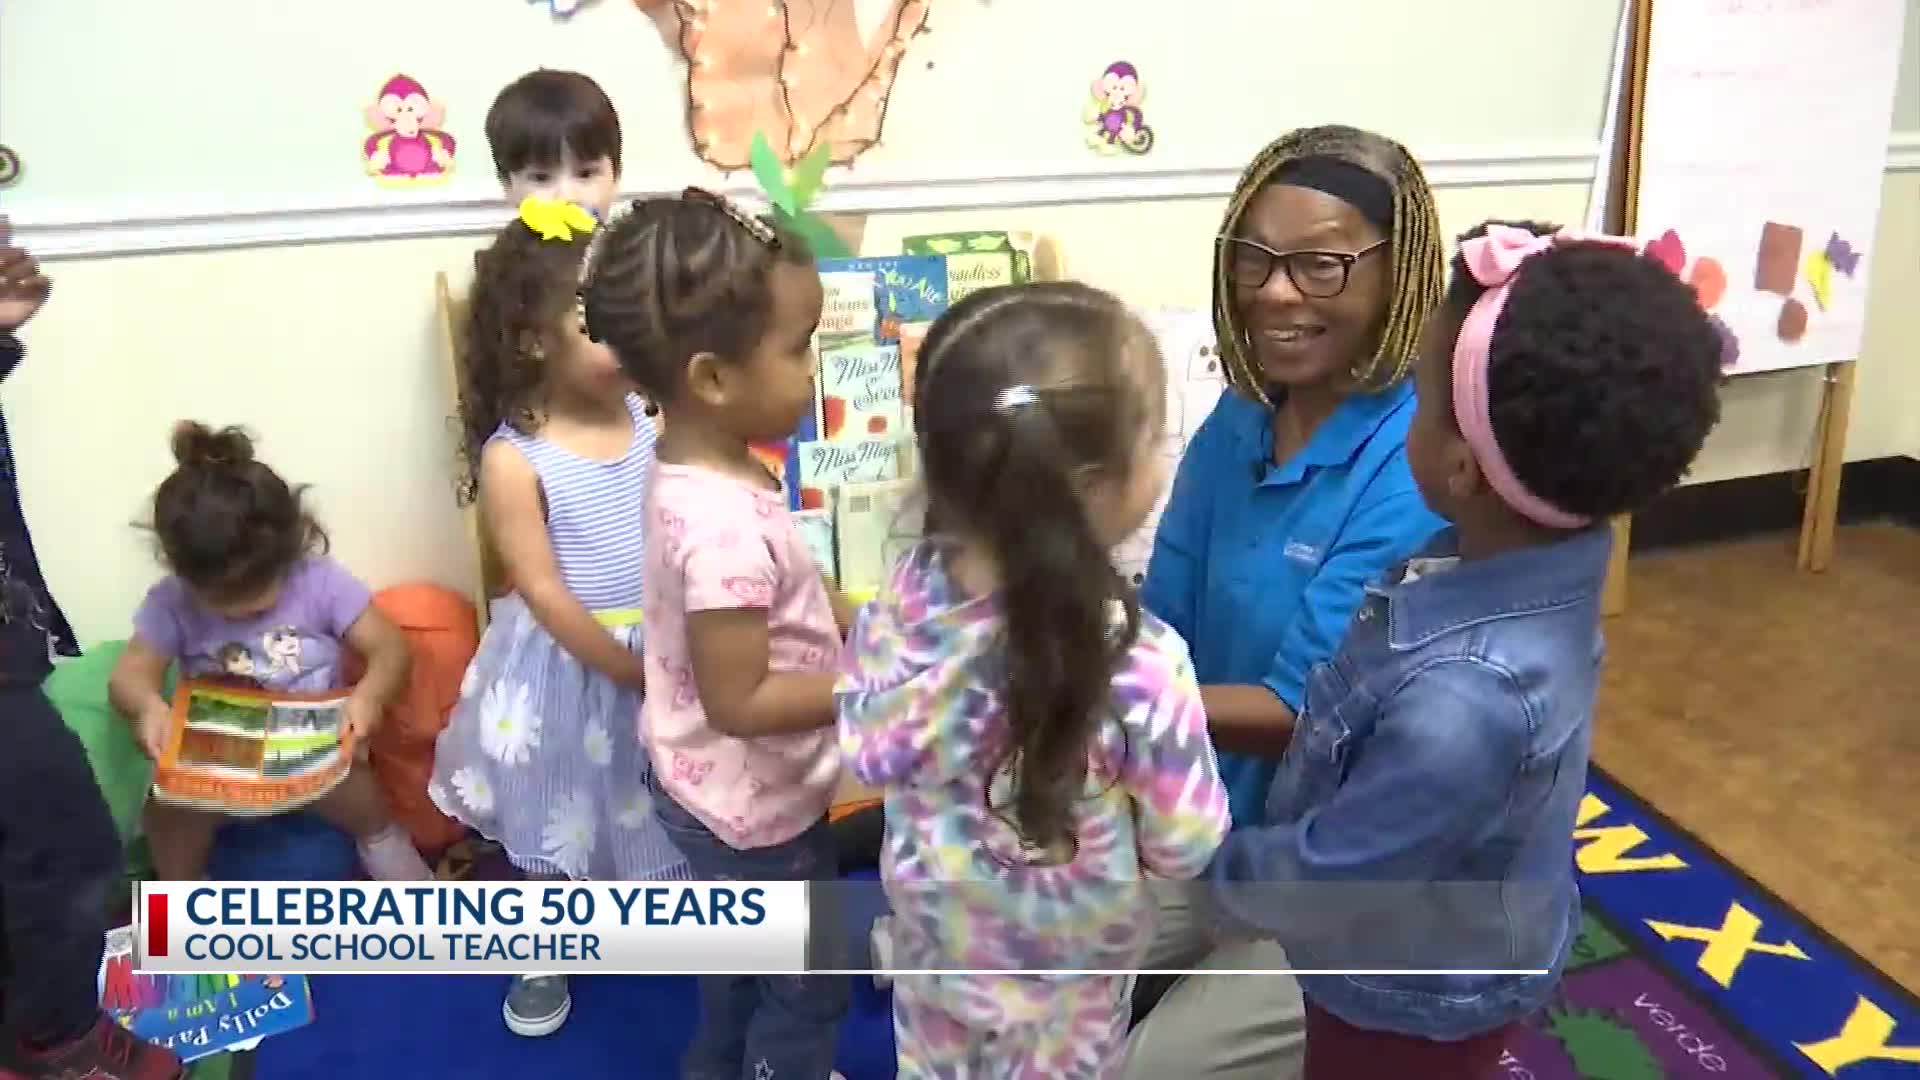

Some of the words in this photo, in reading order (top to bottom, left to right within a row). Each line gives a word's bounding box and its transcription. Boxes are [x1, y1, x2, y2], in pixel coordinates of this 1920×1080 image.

[832, 355, 878, 385] Miss
[812, 447, 857, 476] Miss
[1642, 901, 1812, 988] X
[1791, 994, 1920, 1076] Y
[218, 991, 293, 1034] Dolly
[1634, 992, 1728, 1073] verde
